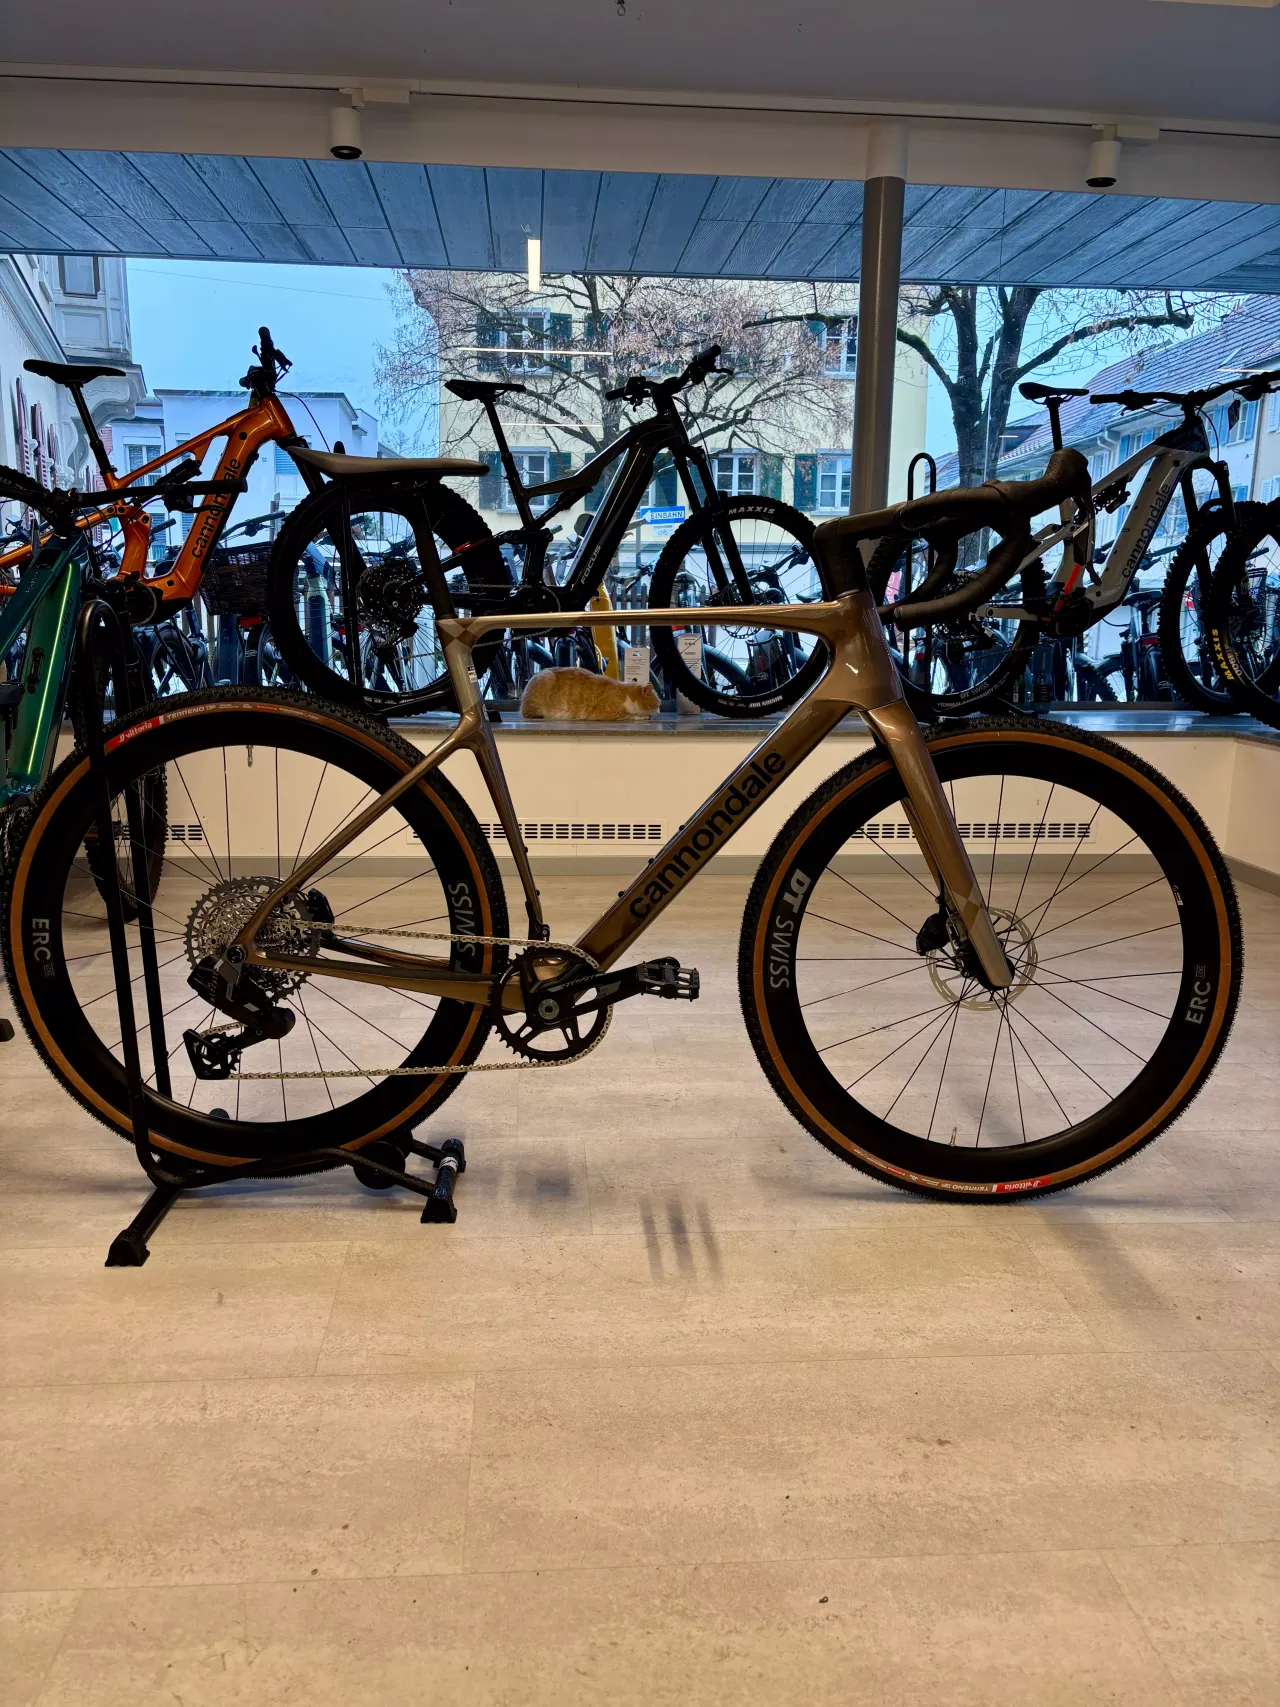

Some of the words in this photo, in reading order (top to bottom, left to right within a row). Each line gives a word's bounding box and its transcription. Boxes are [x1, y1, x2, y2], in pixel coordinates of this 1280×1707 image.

[192, 458, 240, 558] cannonale
[651, 511, 683, 519] EINBAHN
[728, 506, 776, 516] MAXXIS
[1122, 484, 1170, 578] cannondale
[580, 544, 602, 585] FOCUS
[1211, 628, 1235, 681] MAXXIS
[125, 722, 153, 739] vittoria
[167, 706, 205, 720] TERRENO
[629, 751, 786, 921] cannondale
[782, 868, 812, 914] DT
[32, 917, 51, 962] ERC
[448, 881, 476, 957] SWISS
[769, 914, 794, 989] SWISS
[1185, 980, 1211, 1025] ERC
[952, 1184, 989, 1192] TERRENO
[1004, 1180, 1033, 1191] vittoria
